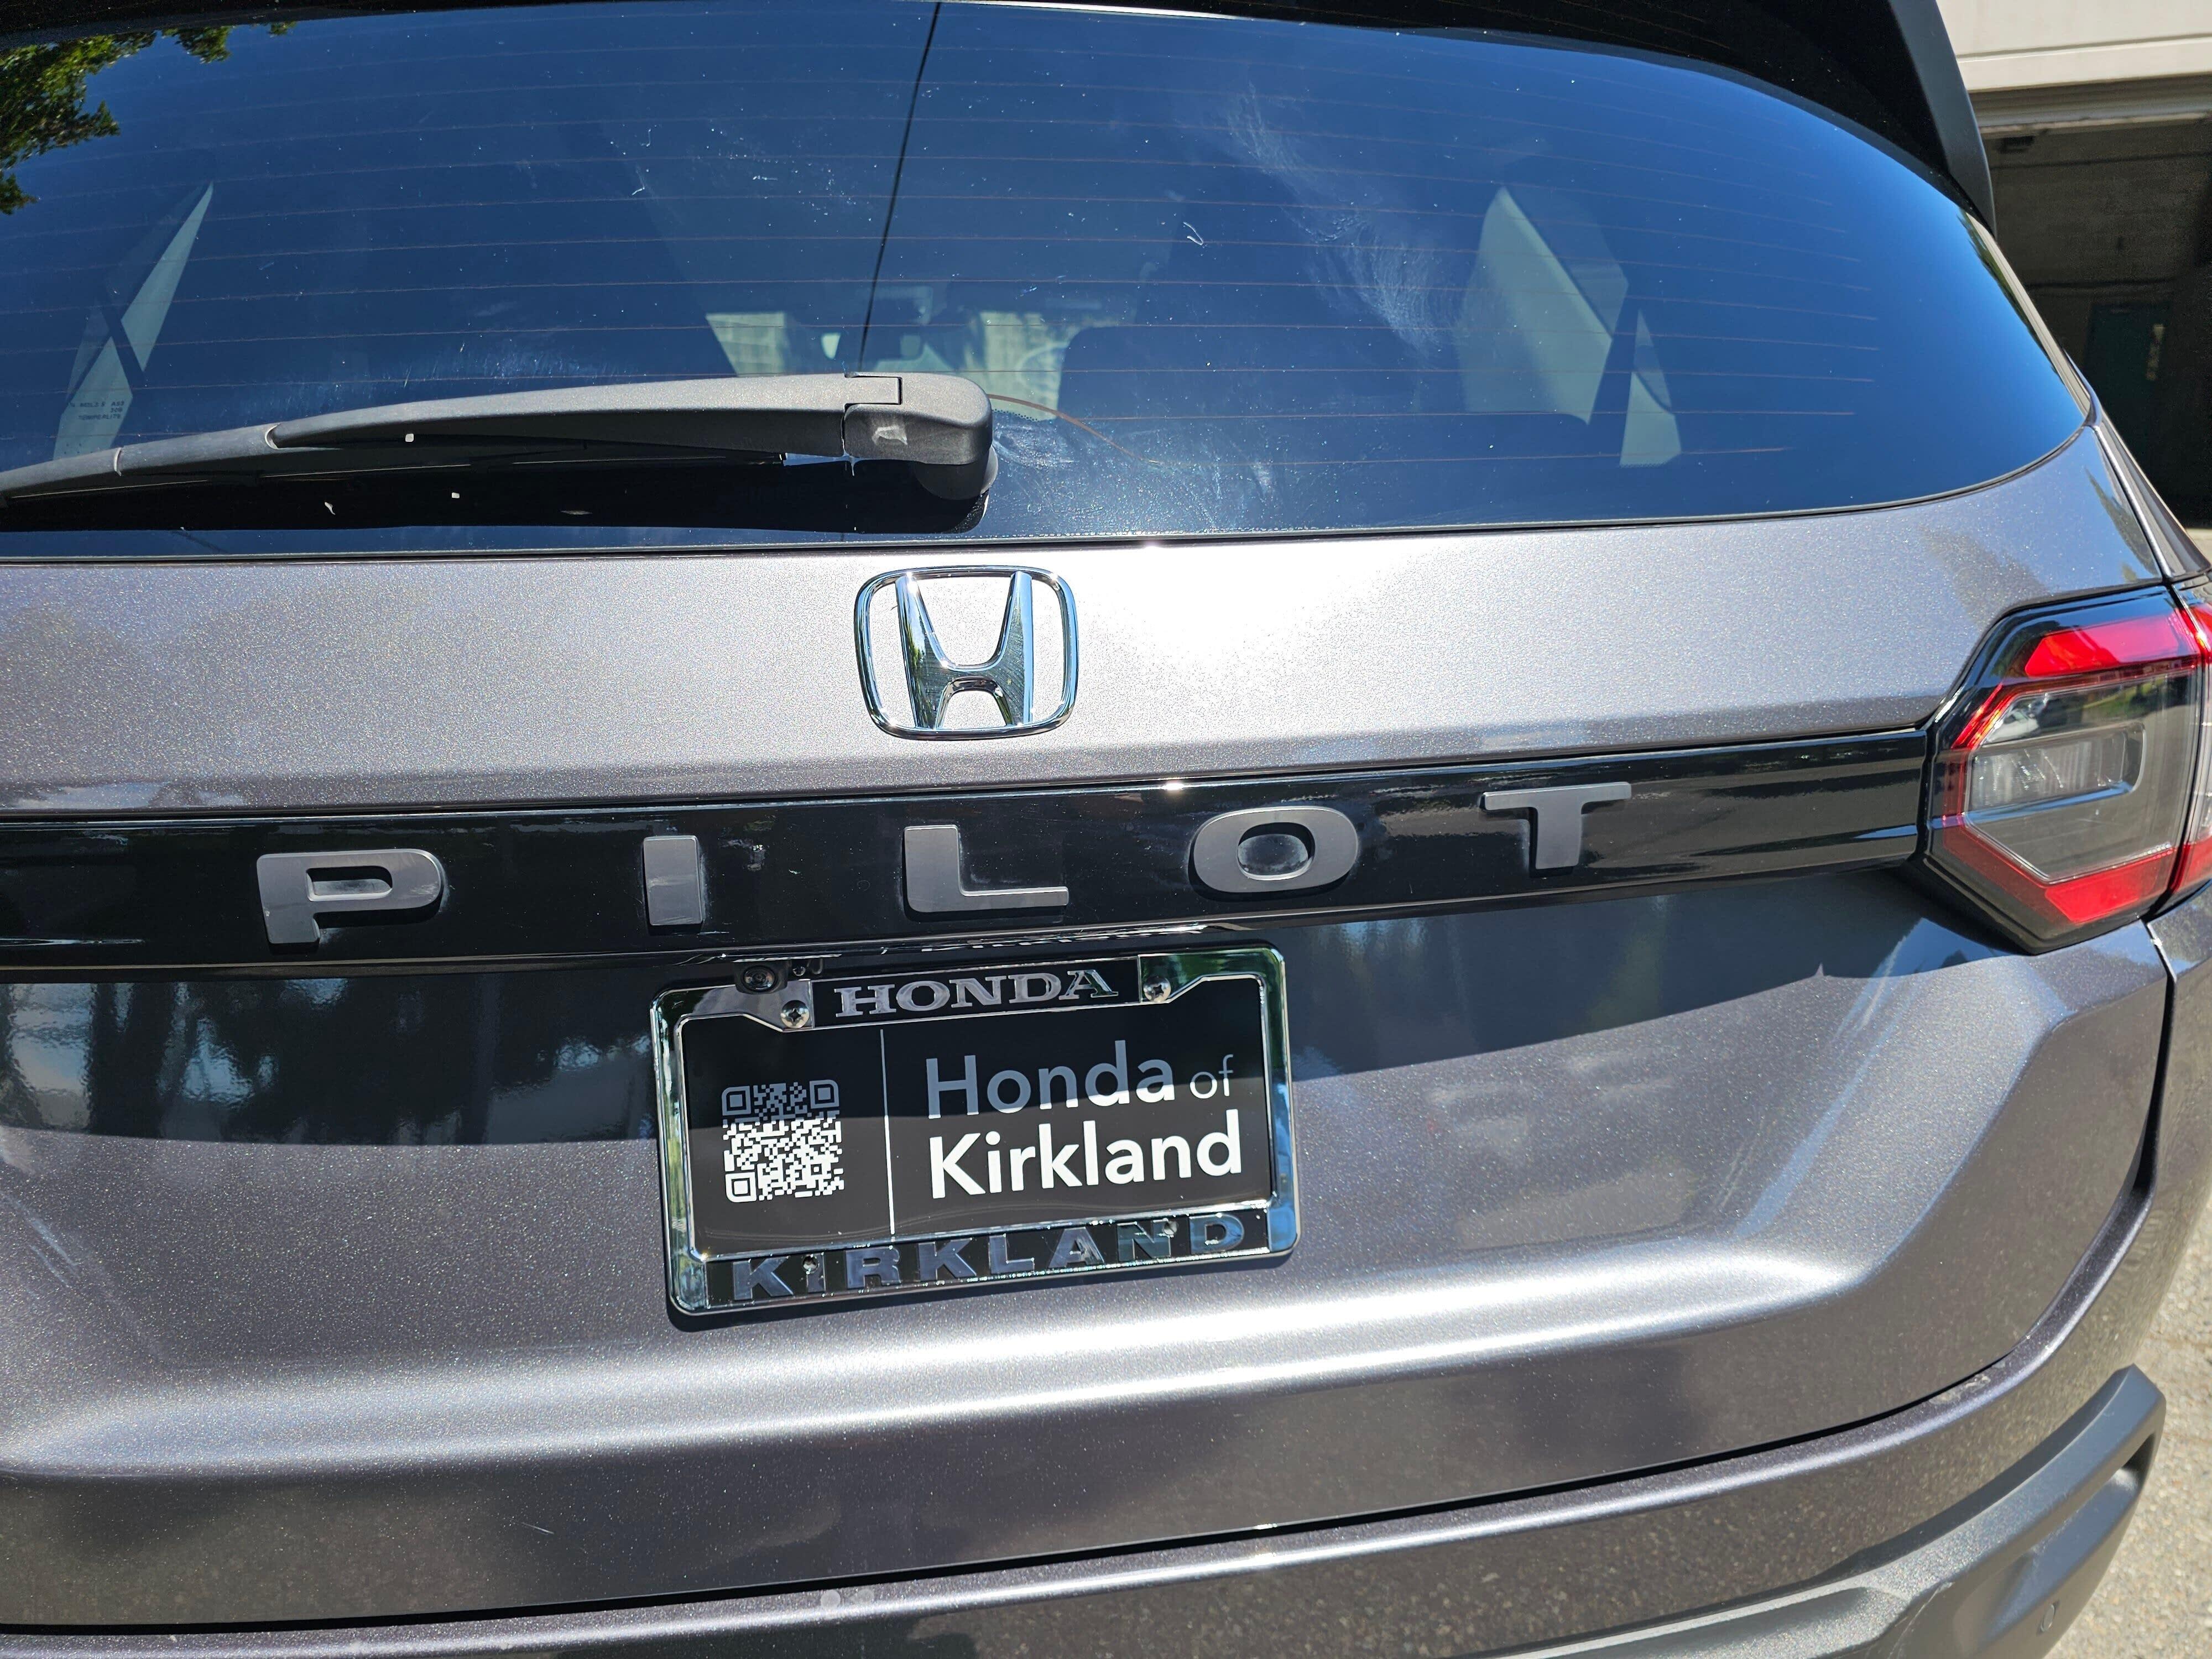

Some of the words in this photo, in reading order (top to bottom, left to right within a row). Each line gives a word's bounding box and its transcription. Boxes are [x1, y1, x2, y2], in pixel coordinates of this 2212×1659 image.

[255, 781, 1632, 945] PILOT
[833, 969, 1119, 1018] HONDA
[926, 1040, 1175, 1119] Honda
[1190, 1053, 1234, 1099] of
[929, 1108, 1242, 1199] Kirkland
[732, 1212, 1245, 1301] KIRKLAND
